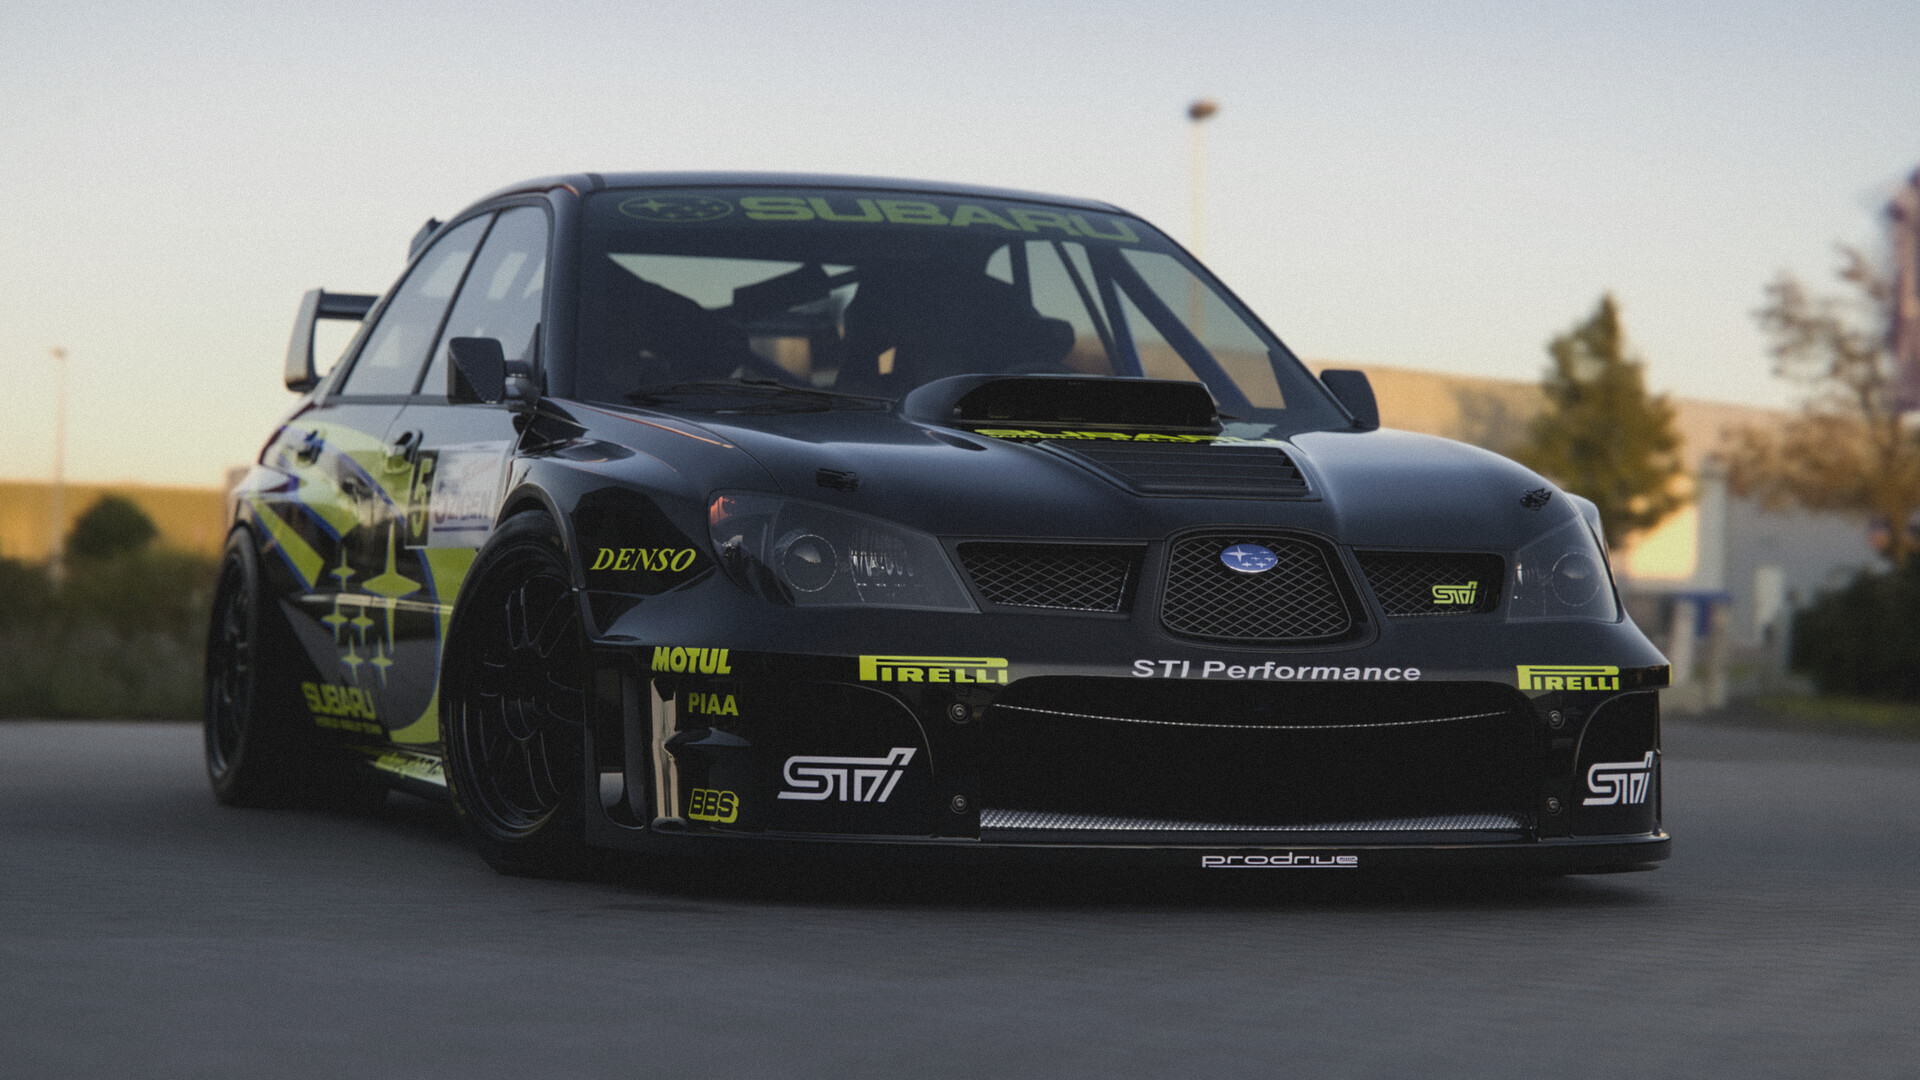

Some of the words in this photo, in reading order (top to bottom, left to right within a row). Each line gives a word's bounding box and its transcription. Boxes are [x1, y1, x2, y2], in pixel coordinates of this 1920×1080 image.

[738, 196, 1140, 242] SUBARU
[589, 547, 697, 572] DENSO
[651, 646, 732, 674] MOTUL
[858, 654, 1009, 683] PIRELLI
[1131, 659, 1191, 679] STI
[1202, 660, 1422, 682] Performance
[1516, 664, 1620, 691] PIRELLI
[688, 692, 740, 717] PIAA
[688, 788, 740, 824] BBS
